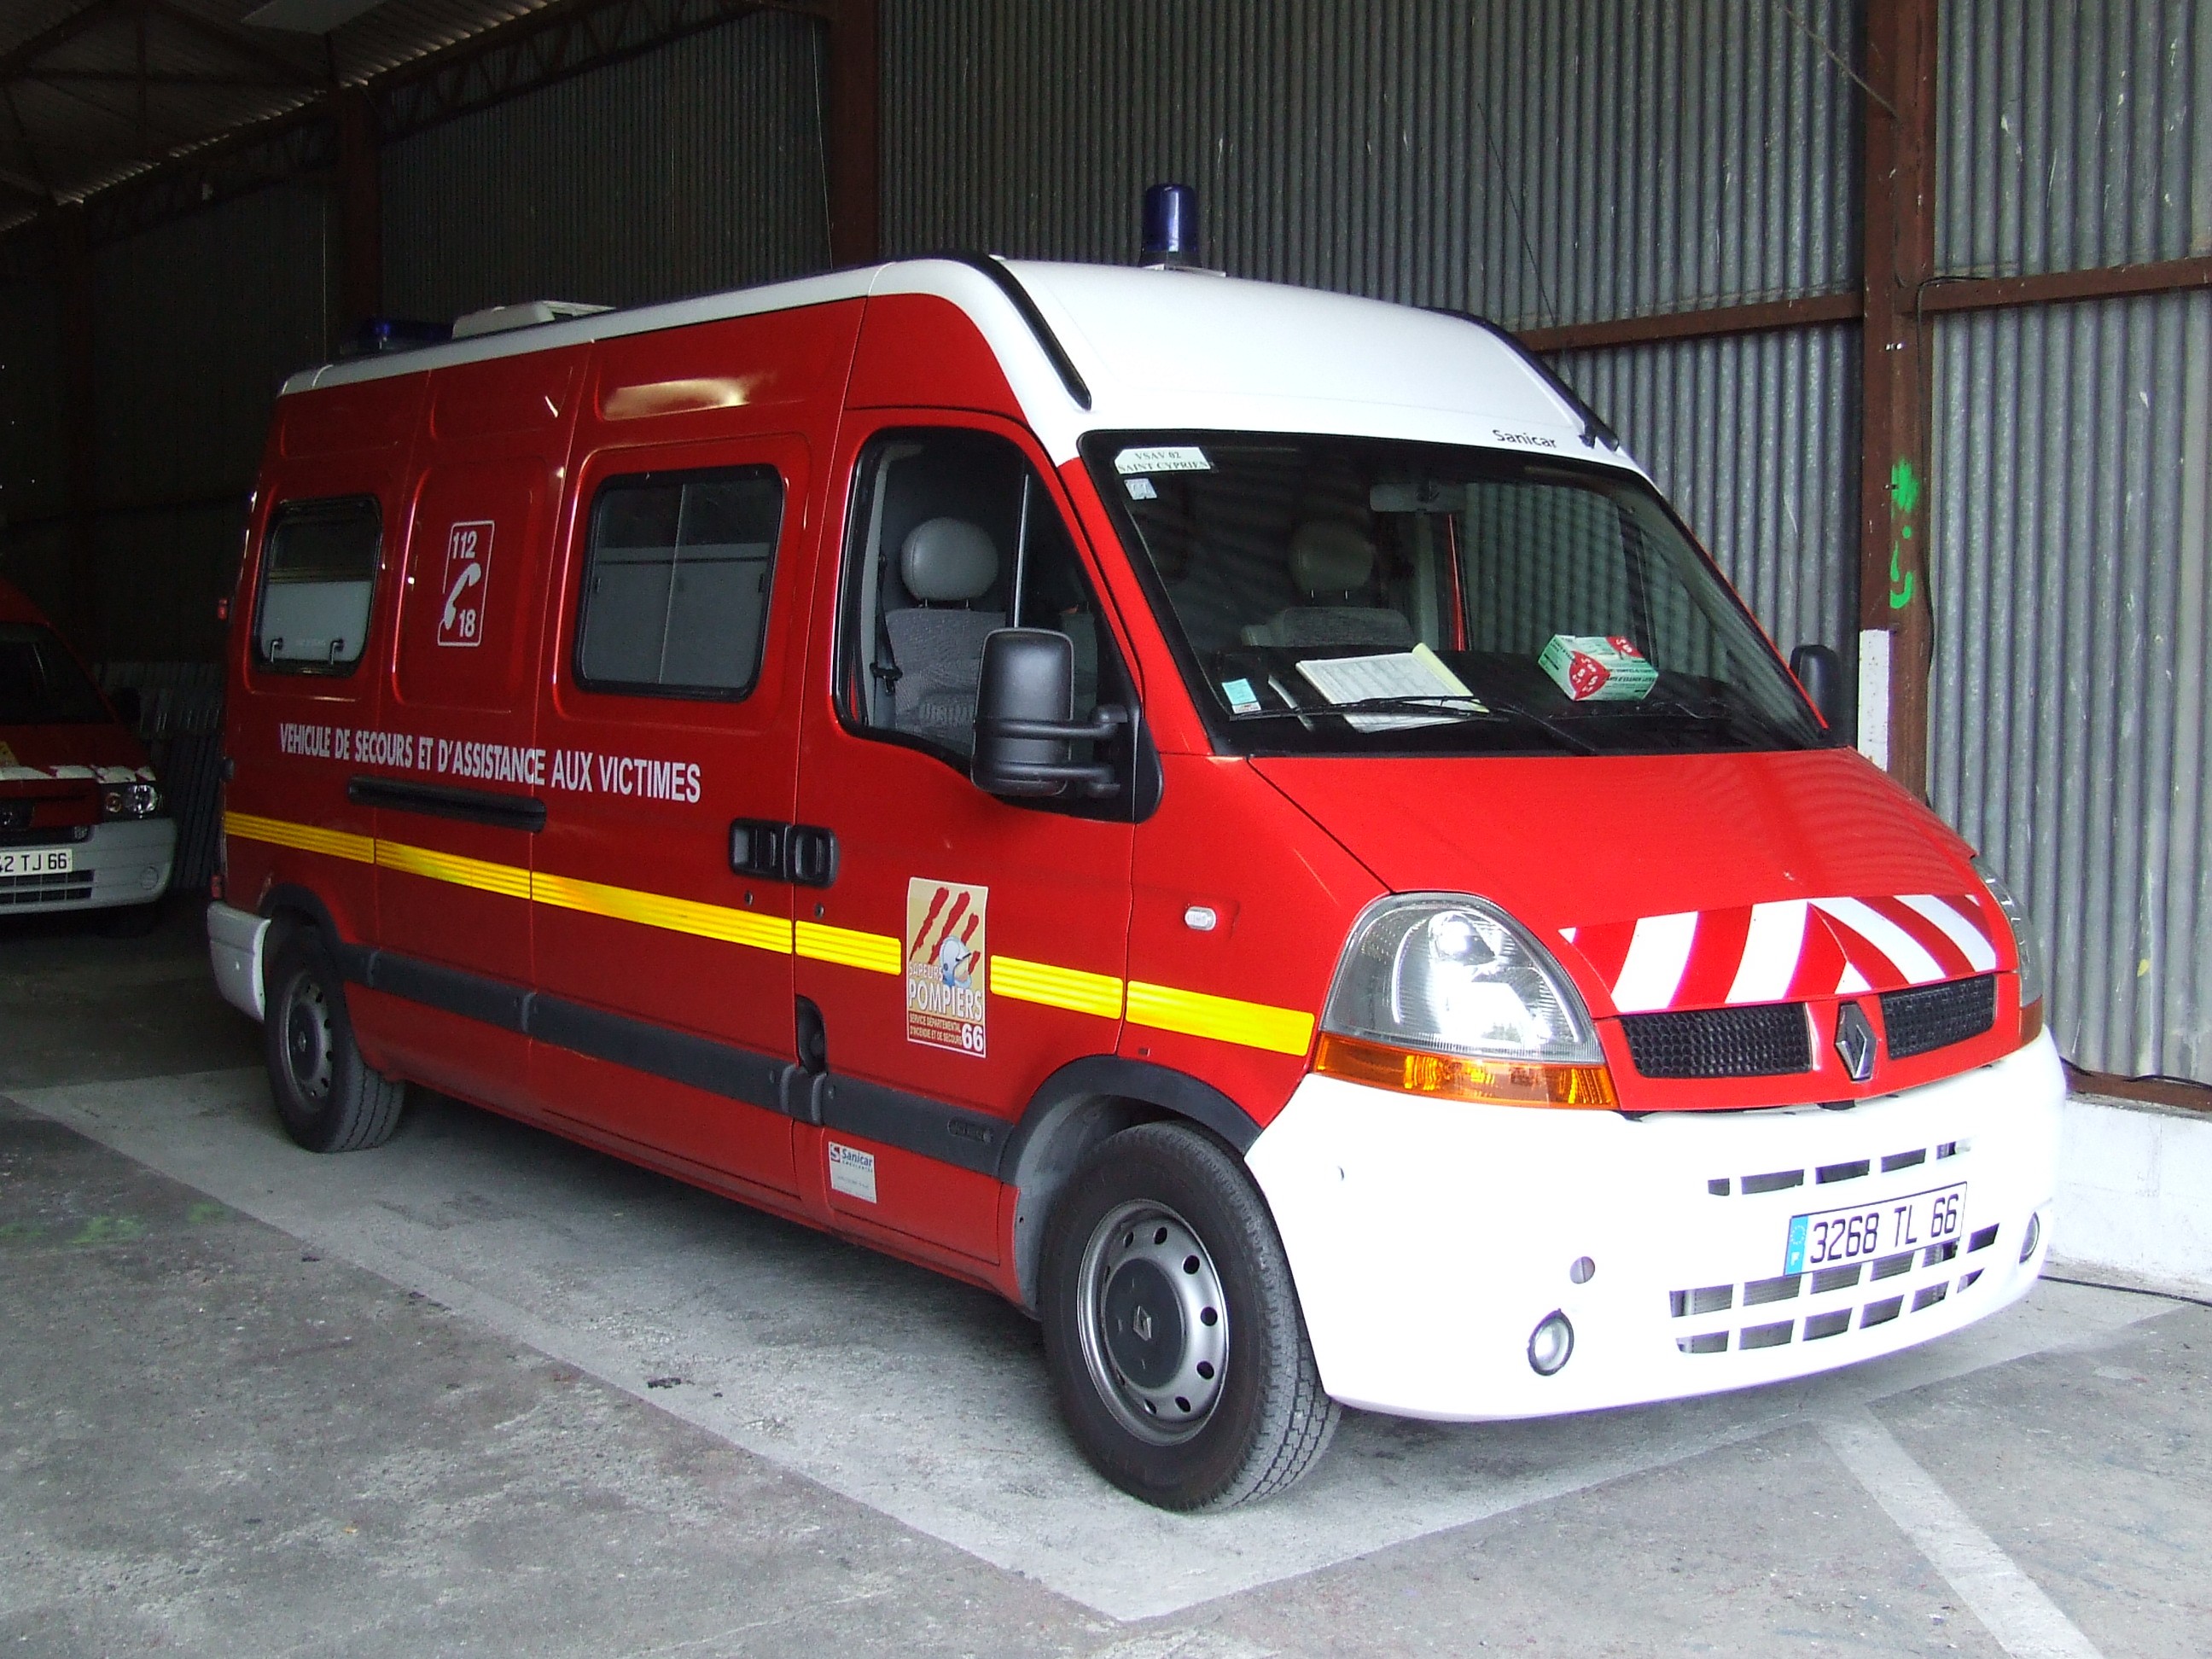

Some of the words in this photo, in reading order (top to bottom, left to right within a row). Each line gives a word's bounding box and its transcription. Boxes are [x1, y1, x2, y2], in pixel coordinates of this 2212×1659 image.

[1492, 429, 1557, 448] Sanicar
[1135, 451, 1165, 460] VSAV
[1117, 463, 1154, 473] SAINT
[452, 530, 478, 560] 112
[459, 608, 476, 638] 18
[280, 723, 331, 758] VEHICULE
[335, 728, 351, 760] DE
[355, 730, 413, 768] SECOURS
[417, 736, 434, 771] ET
[438, 739, 546, 786] D'ASSISTANCE
[550, 749, 593, 793] AUX
[599, 754, 701, 803] VICTIMES
[21, 853, 42, 871] TJ
[49, 853, 67, 870] 66
[909, 962, 944, 981] SAPEURS
[908, 978, 983, 1022] POMPIERS
[962, 1023, 984, 1052] 66
[841, 1148, 873, 1167] Sanicar
[1809, 1212, 1880, 1265] 3268
[1893, 1203, 1918, 1249] TL
[1930, 1193, 1959, 1238] 66
